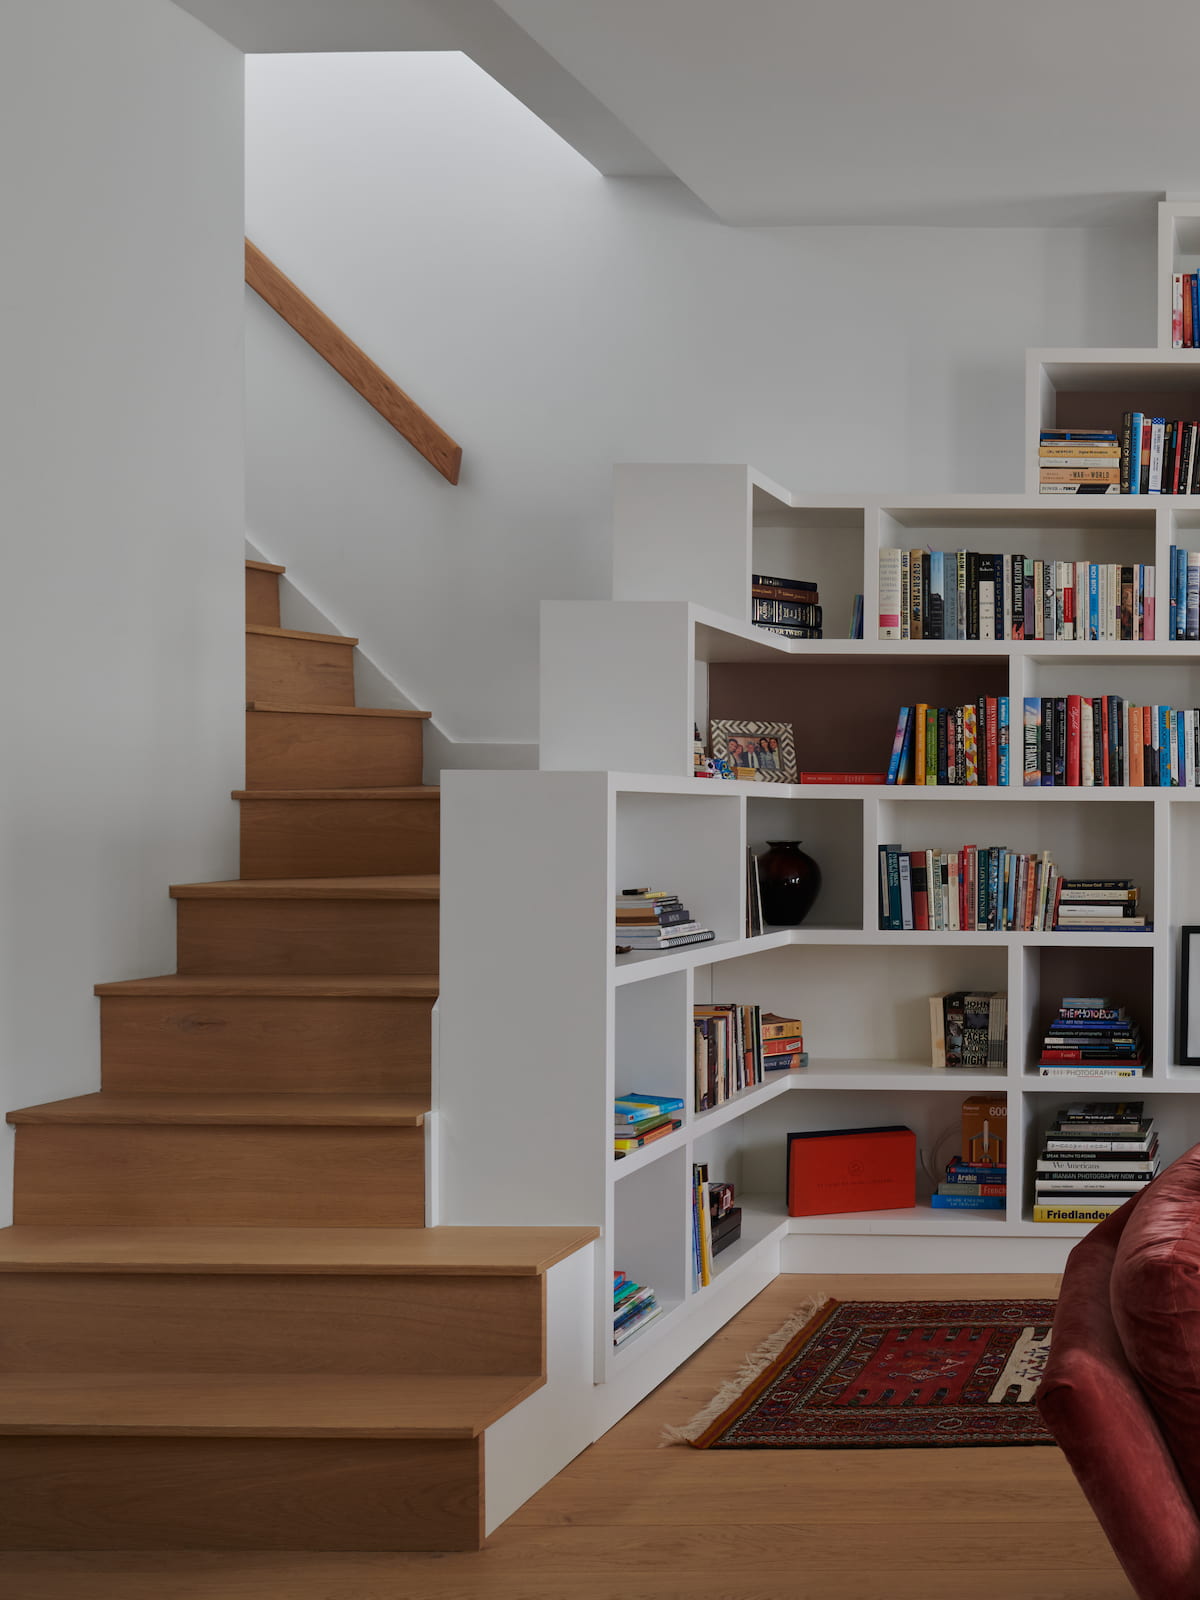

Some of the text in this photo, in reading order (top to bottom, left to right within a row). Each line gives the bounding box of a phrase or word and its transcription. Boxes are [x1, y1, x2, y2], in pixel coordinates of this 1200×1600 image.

[1014, 562, 1023, 613] LUCIFER PRINCIPLE
[1025, 746, 1037, 772] FRANZEN
[962, 1032, 989, 1041] FACES
[961, 1056, 988, 1065] NIGHT
[1047, 1210, 1110, 1220] Friedlander
